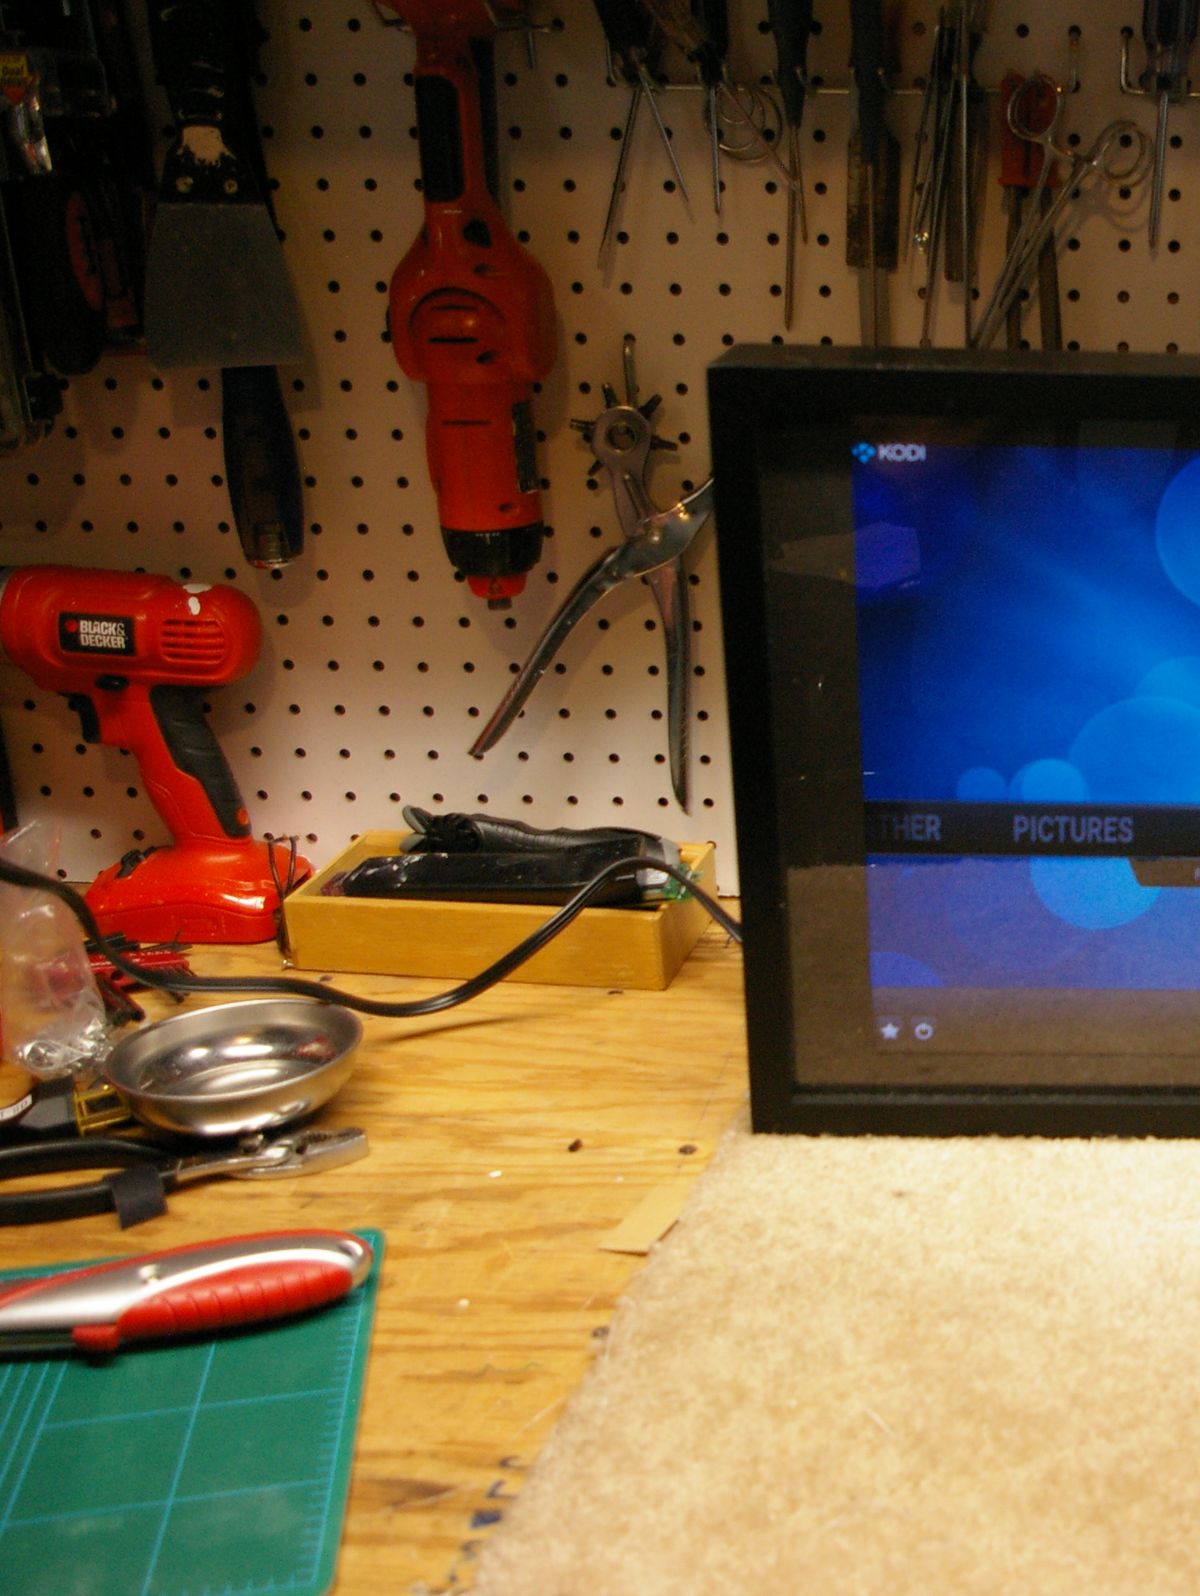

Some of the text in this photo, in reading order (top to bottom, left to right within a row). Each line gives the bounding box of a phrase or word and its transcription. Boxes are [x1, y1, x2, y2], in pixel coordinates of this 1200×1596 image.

[878, 443, 927, 462] KODI
[80, 634, 126, 649] DECKER
[1012, 814, 1134, 842] PICTURES
